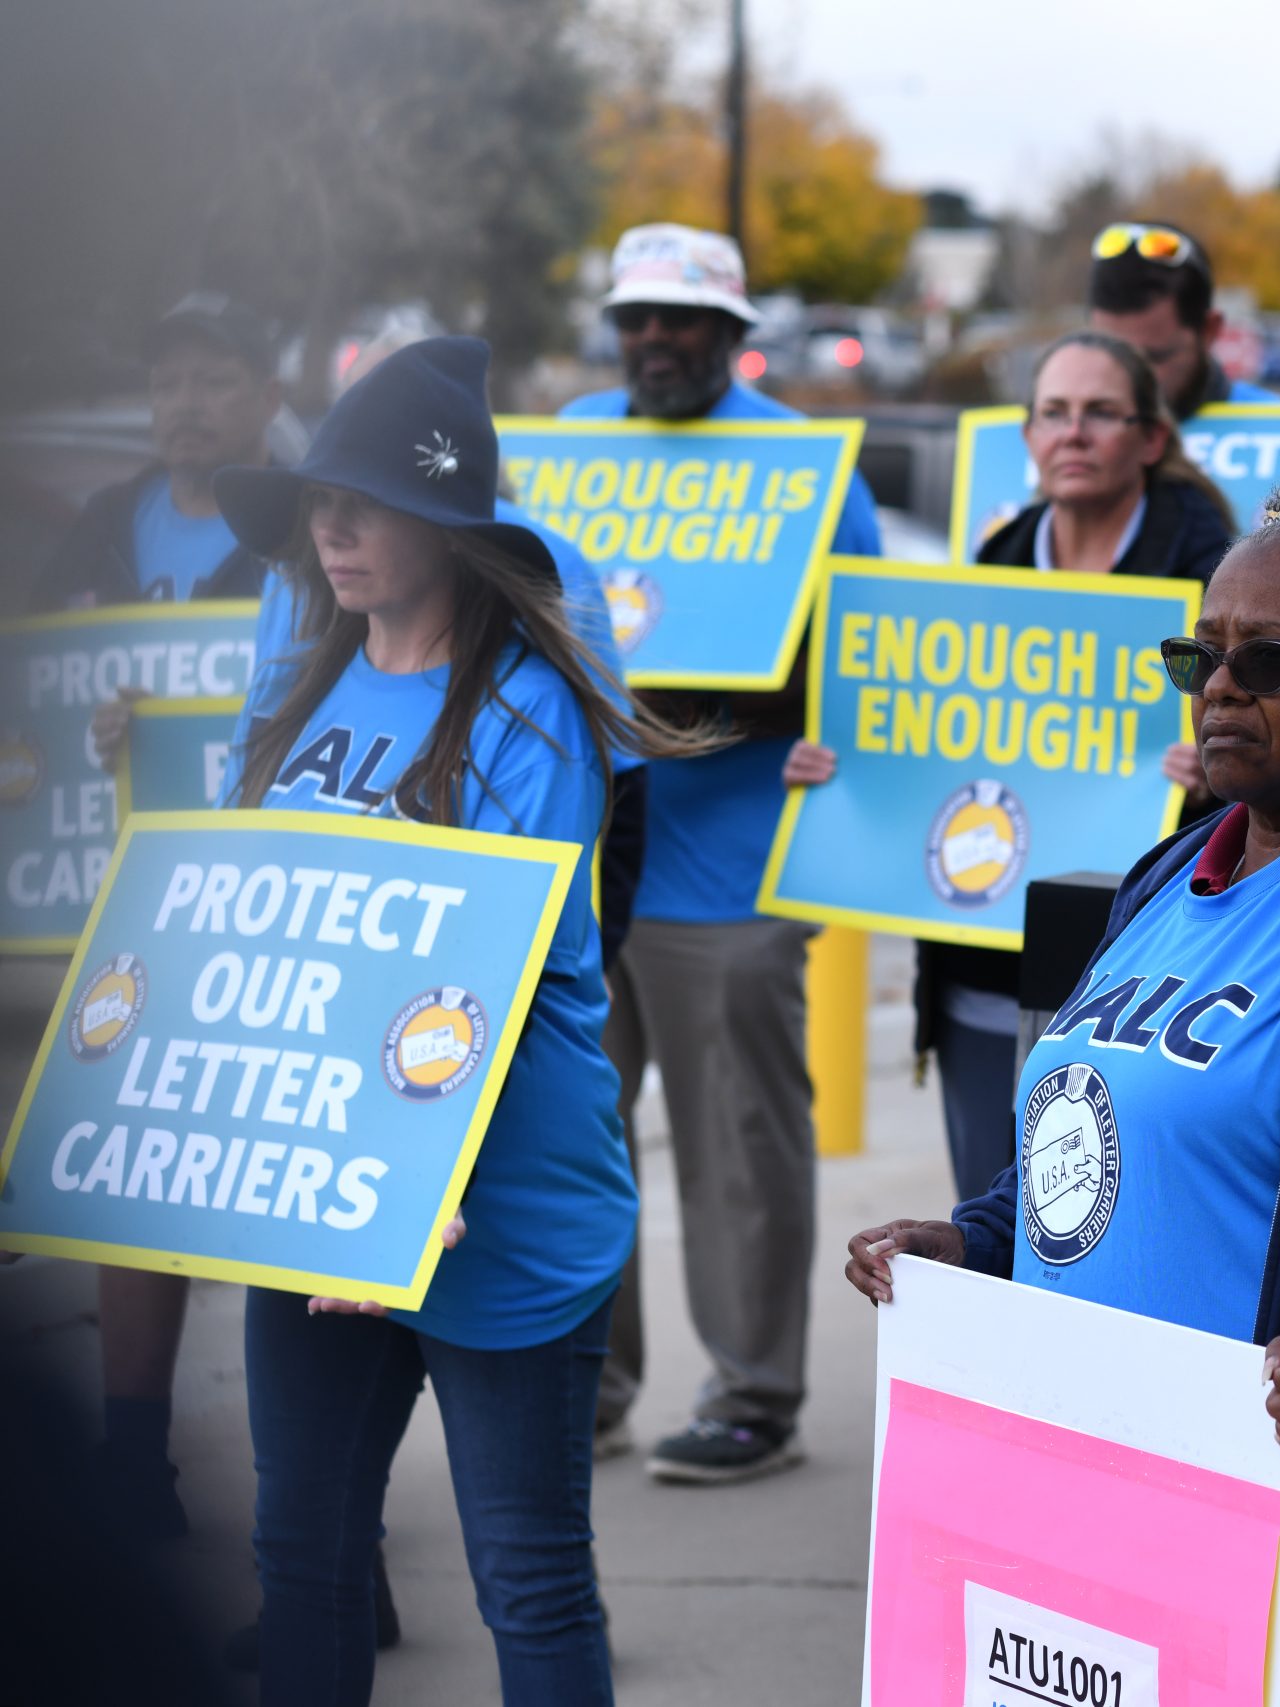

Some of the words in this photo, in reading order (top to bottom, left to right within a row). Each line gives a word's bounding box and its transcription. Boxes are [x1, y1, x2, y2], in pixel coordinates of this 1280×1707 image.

[505, 458, 754, 511] ENOUGH
[762, 469, 819, 511] IS
[528, 512, 785, 563] NOUGH!
[837, 613, 1098, 698] ENOUGH
[1115, 646, 1166, 704] IS
[855, 687, 1139, 777] ENOUGH!
[153, 864, 466, 957] PROTECT
[191, 952, 341, 1035] OUR
[1038, 971, 1258, 1071] NALC
[117, 1037, 363, 1133] LETTER
[1023, 1076, 1059, 1167] ASSOCIATION
[1094, 1088, 1107, 1108] OF
[50, 1121, 389, 1231] CARRIERS
[1042, 1158, 1071, 1195] U.S.A.
[1100, 1107, 1116, 1171] LETTER
[1080, 1177, 1115, 1249] CARRIERS
[989, 1627, 1122, 1707] ATU1001
